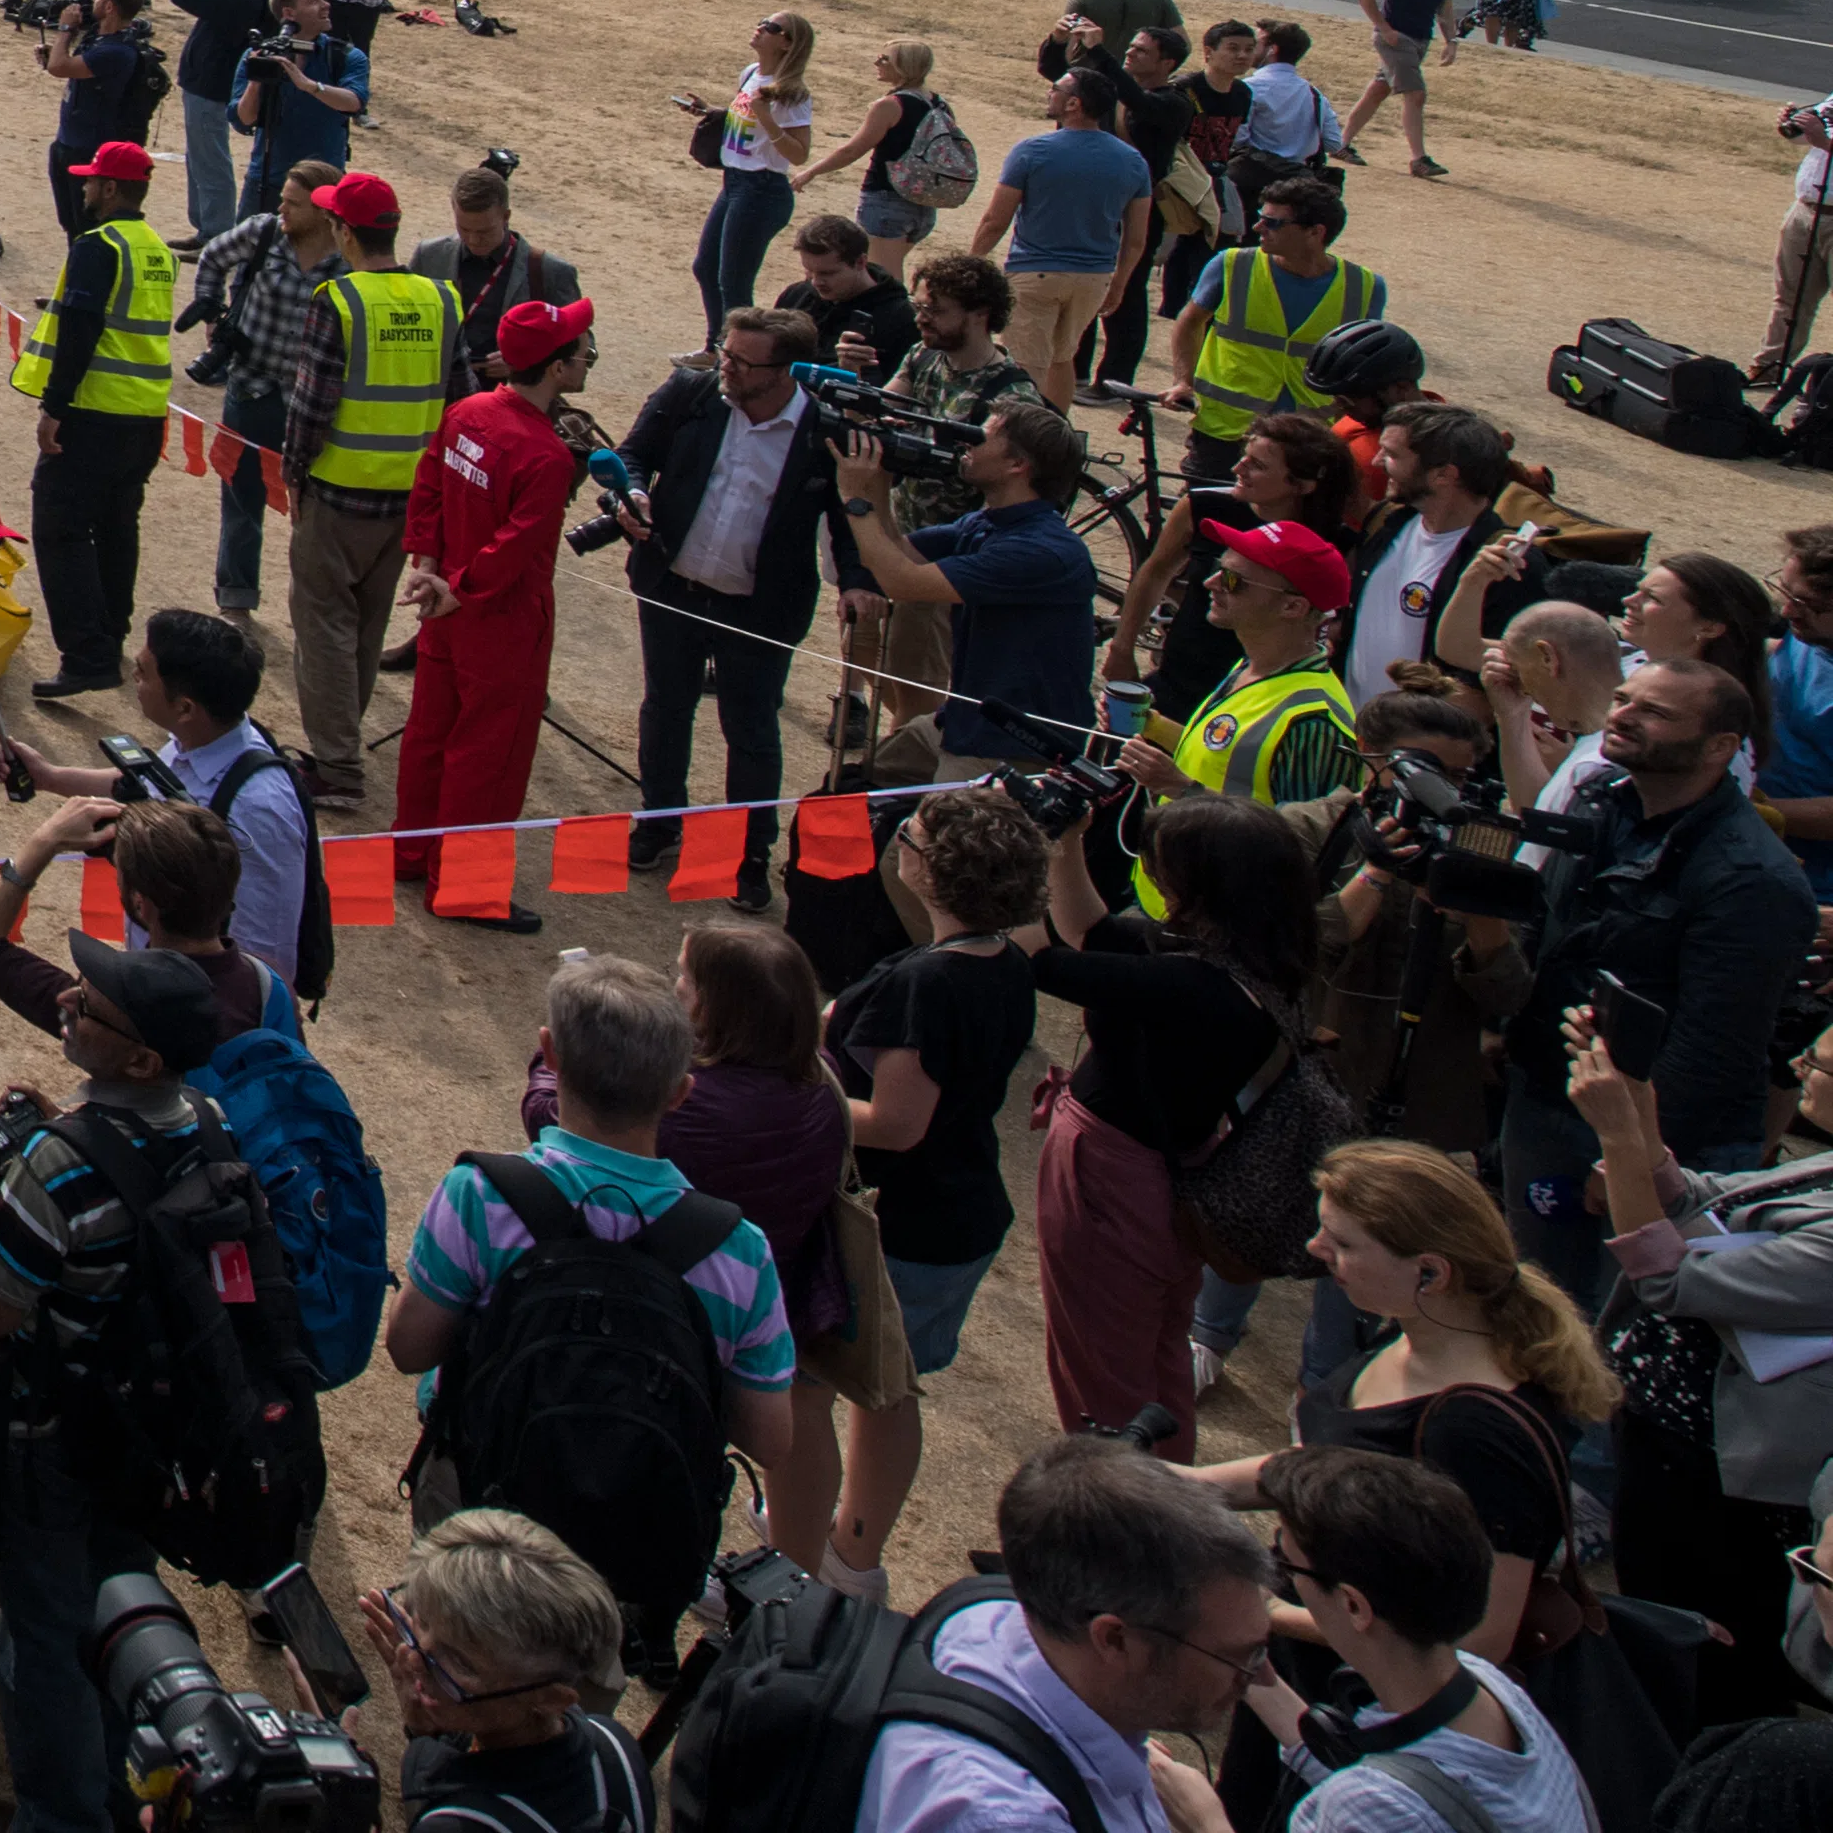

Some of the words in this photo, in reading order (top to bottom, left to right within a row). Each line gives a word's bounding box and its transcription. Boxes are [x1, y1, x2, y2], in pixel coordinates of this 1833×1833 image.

[389, 312, 421, 327] TRUMP
[379, 328, 434, 343] BABYSITTER
[456, 433, 485, 464] TRUMP
[444, 446, 489, 491] BABYSITTER
